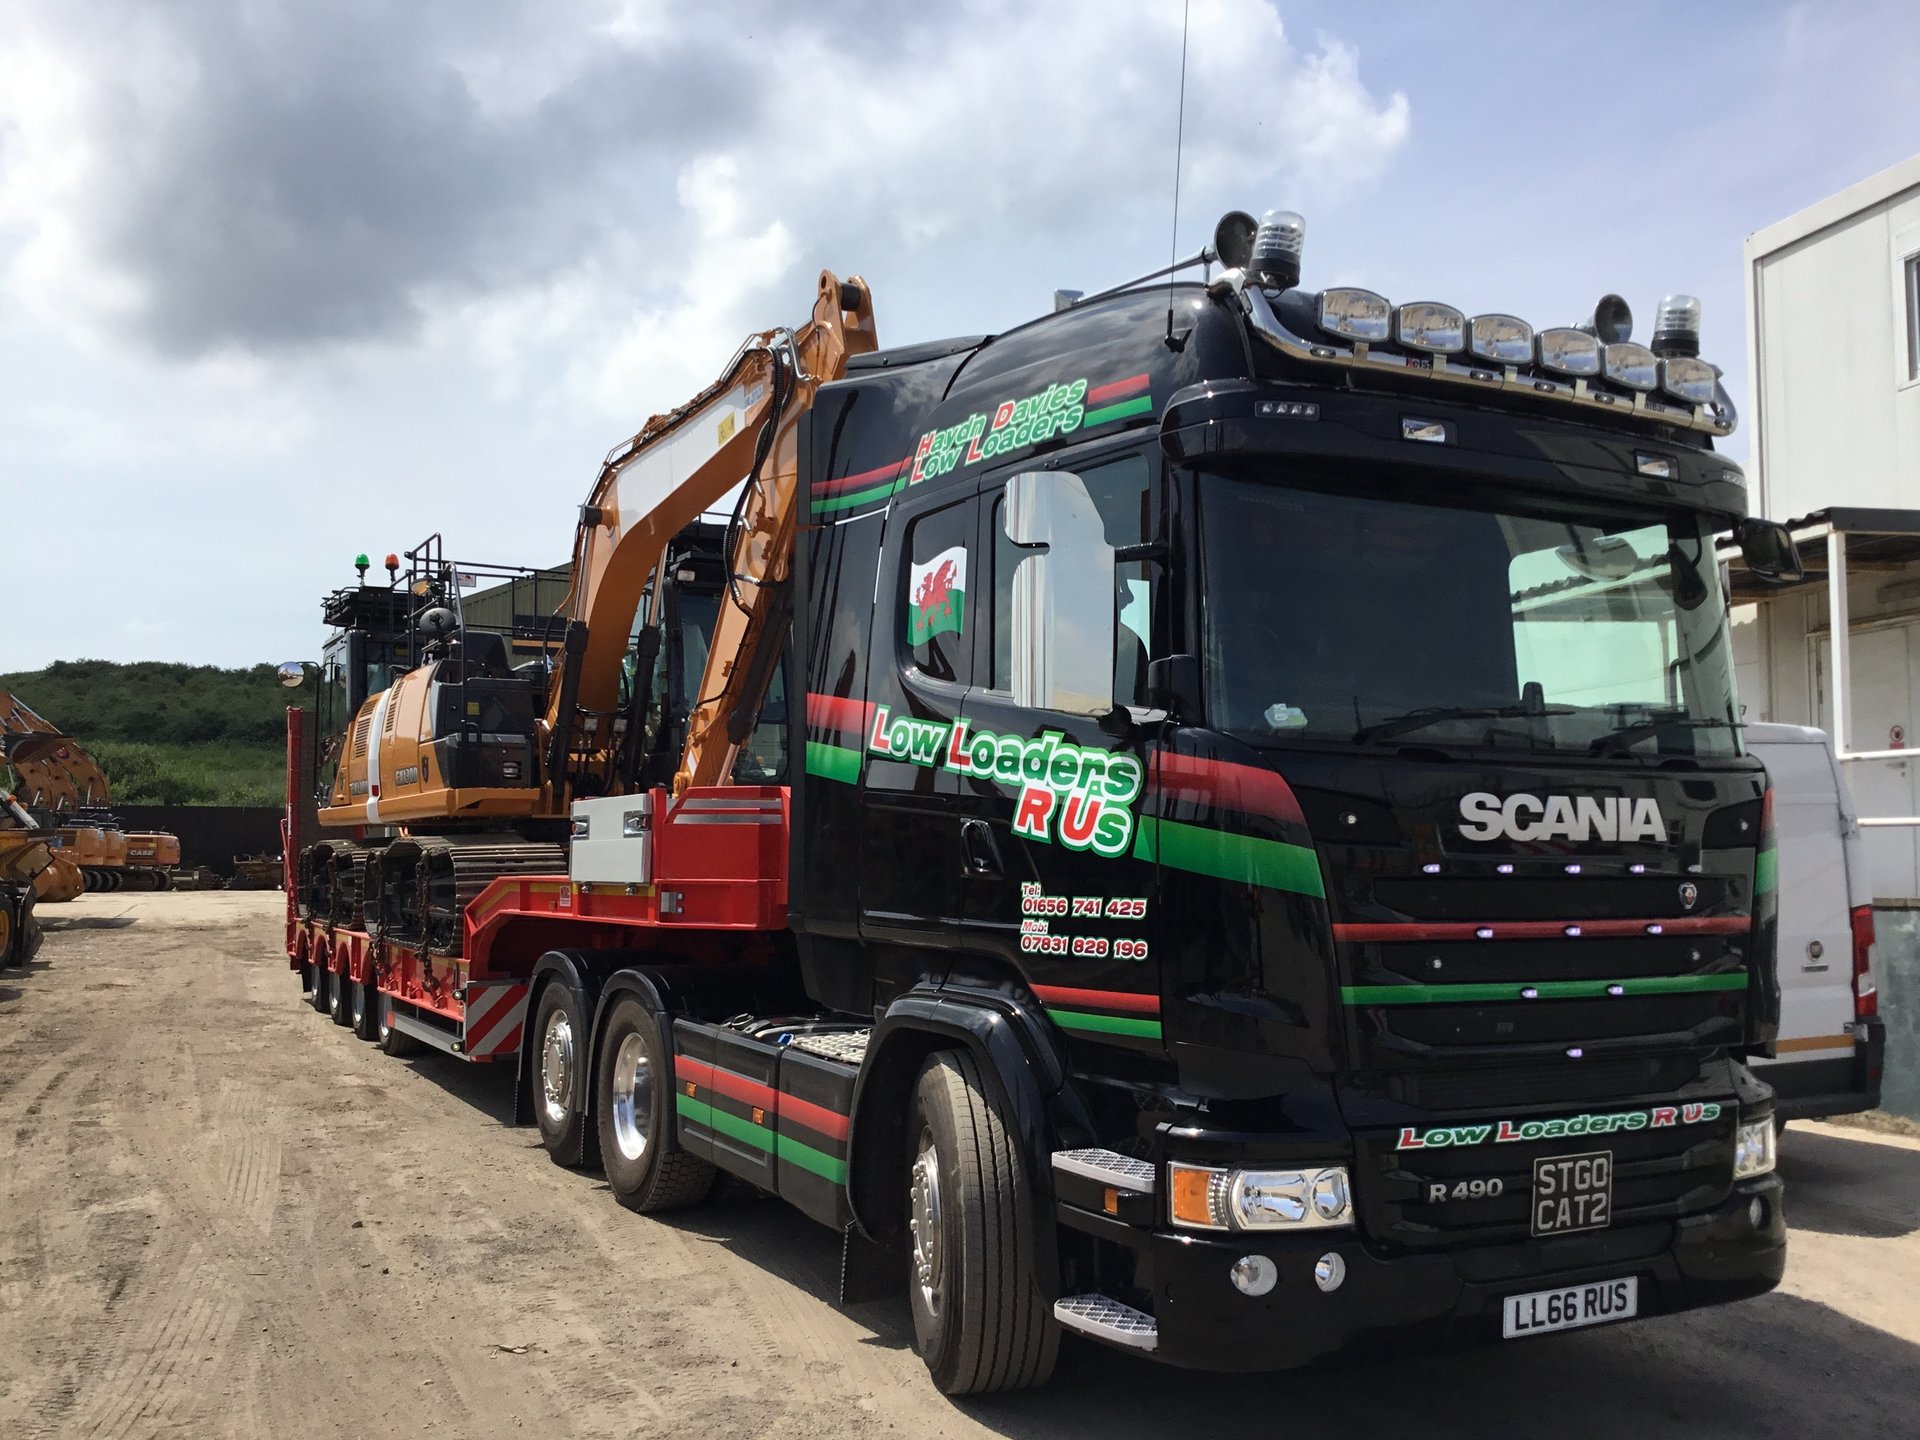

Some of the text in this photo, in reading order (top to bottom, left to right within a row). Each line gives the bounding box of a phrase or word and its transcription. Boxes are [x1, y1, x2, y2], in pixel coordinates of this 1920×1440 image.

[915, 378, 1088, 459] Haydn Davies
[910, 404, 1085, 486] Low Loaders
[868, 707, 1142, 801] Low Loaders
[1013, 785, 1131, 853] R Us
[1458, 792, 1668, 842] SCANIA
[1022, 882, 1041, 897] Tel:
[1022, 898, 1147, 919] 01656 741 425
[1021, 920, 1048, 934] Mob:
[1021, 935, 1148, 959] 07831 828 196
[1397, 1102, 1722, 1149] Low Loaders R Us
[1429, 1177, 1503, 1203] R 490
[1539, 1157, 1609, 1194] STGO
[1537, 1192, 1608, 1230] CAT2
[1515, 1282, 1628, 1331] LL66 RUS
